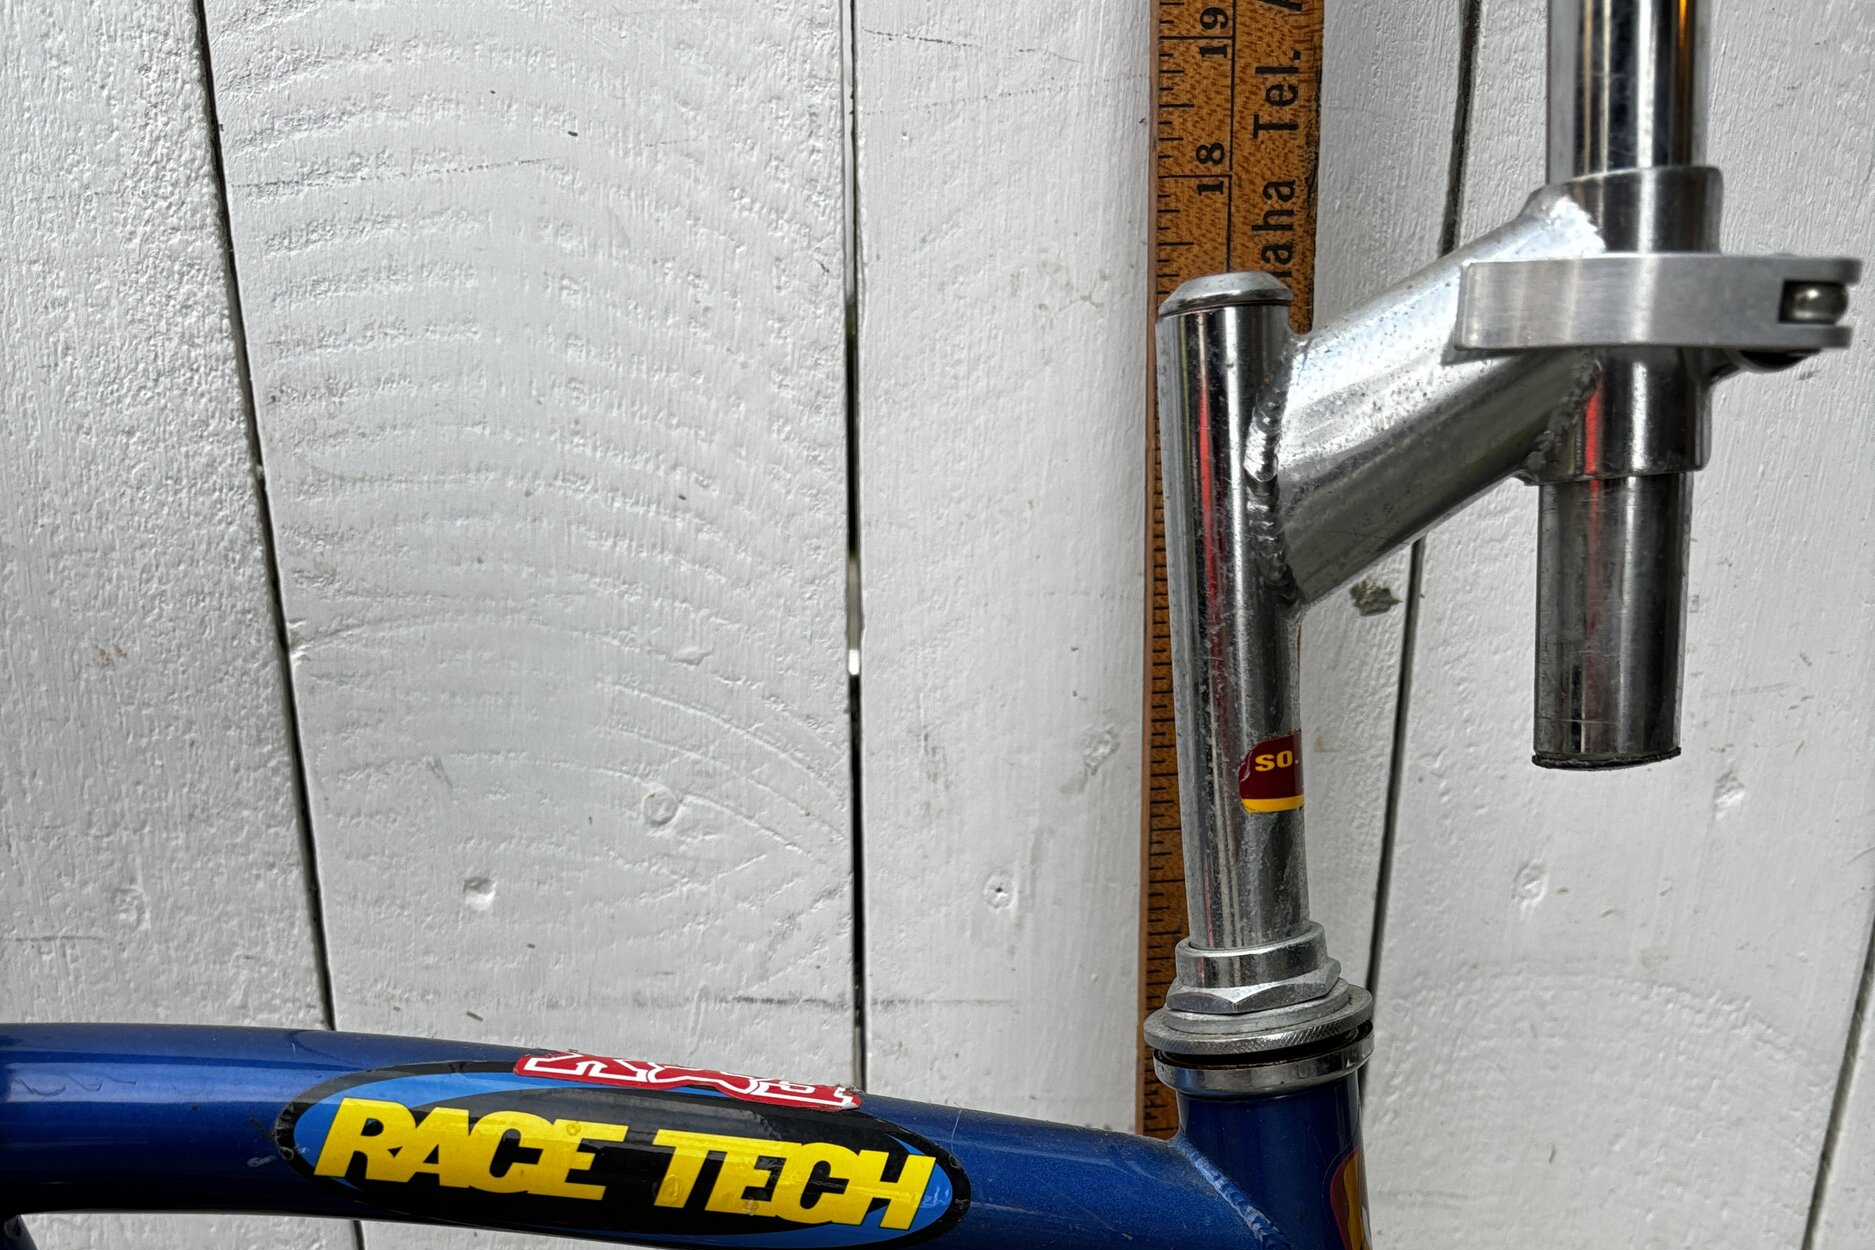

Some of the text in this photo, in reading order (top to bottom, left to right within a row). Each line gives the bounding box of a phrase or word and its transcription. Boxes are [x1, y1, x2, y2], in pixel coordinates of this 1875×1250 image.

[1199, 7, 1229, 59] 19
[1252, 50, 1301, 139] Tel.
[1195, 142, 1225, 196] 18
[1251, 179, 1297, 278] aha
[313, 1097, 936, 1231] RACE TECH
